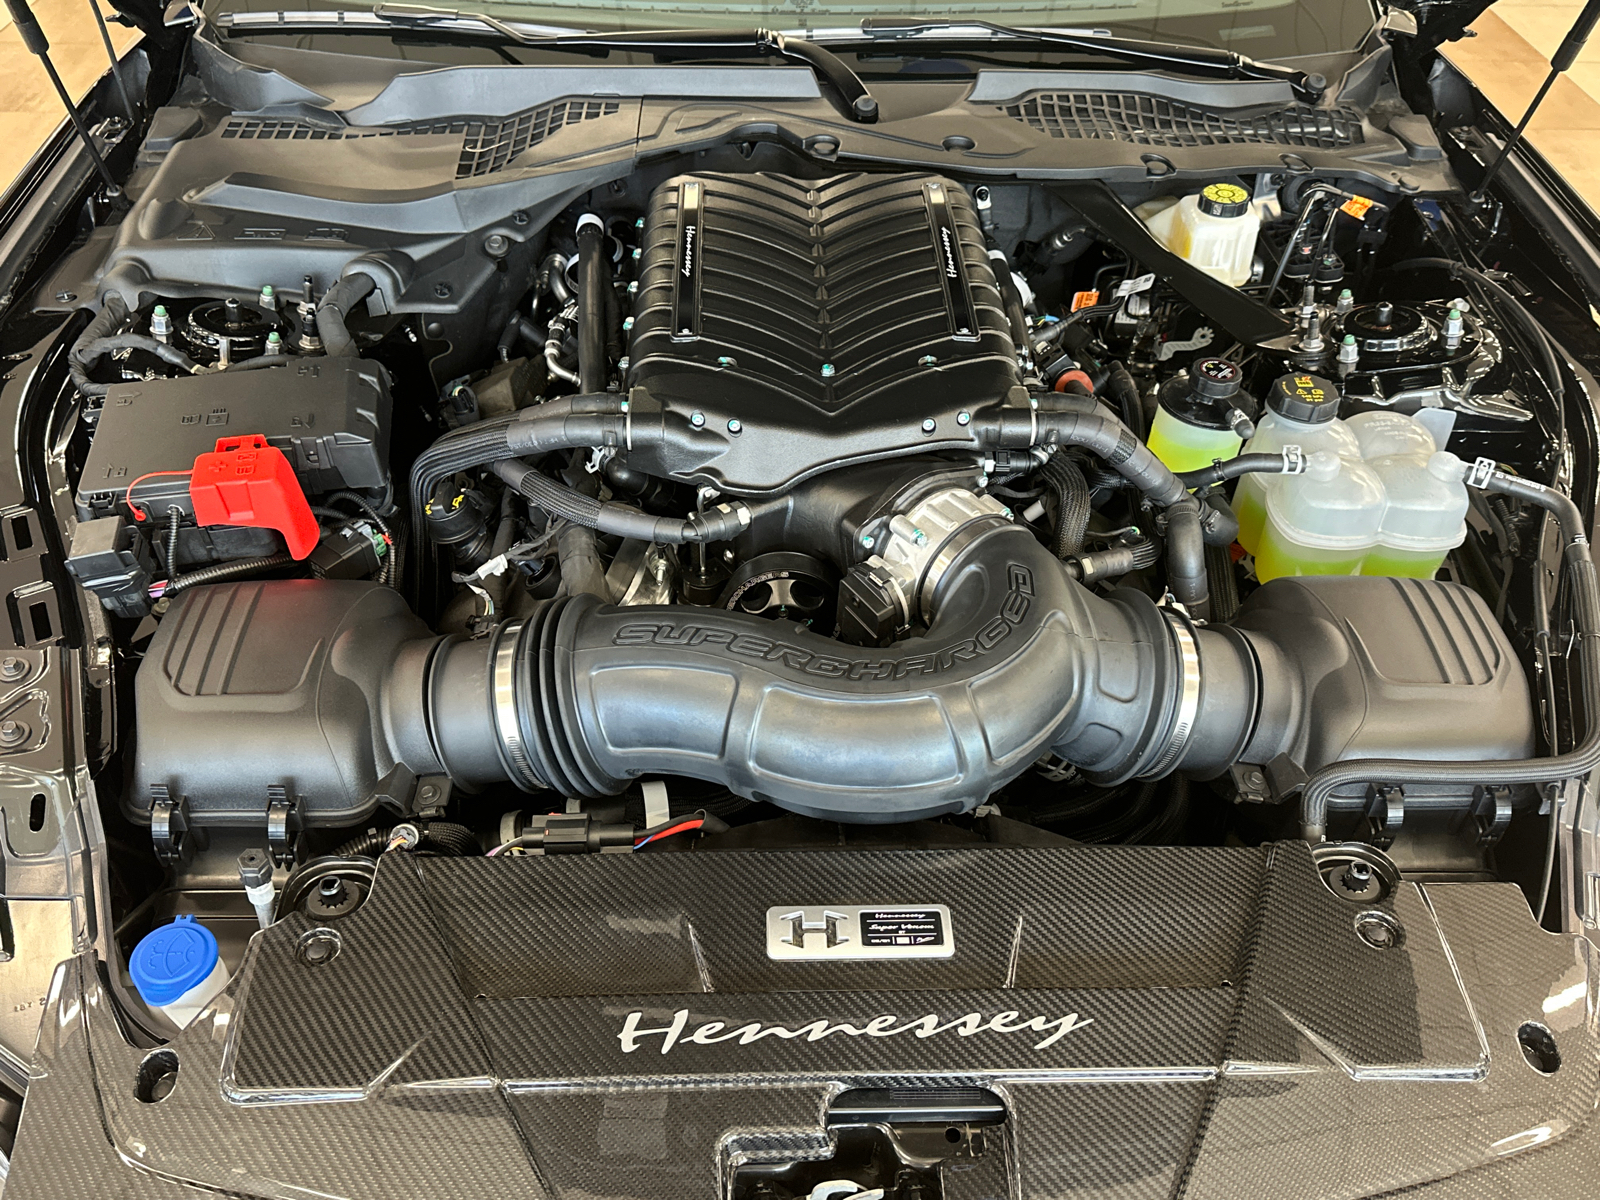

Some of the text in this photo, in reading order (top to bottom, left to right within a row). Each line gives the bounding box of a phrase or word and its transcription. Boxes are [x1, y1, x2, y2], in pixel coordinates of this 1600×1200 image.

[681, 225, 697, 278] Hennessey
[939, 226, 958, 278] Hennessey
[612, 562, 1036, 681] SUPERCHARGED
[617, 1008, 1095, 1055] Hennessey
